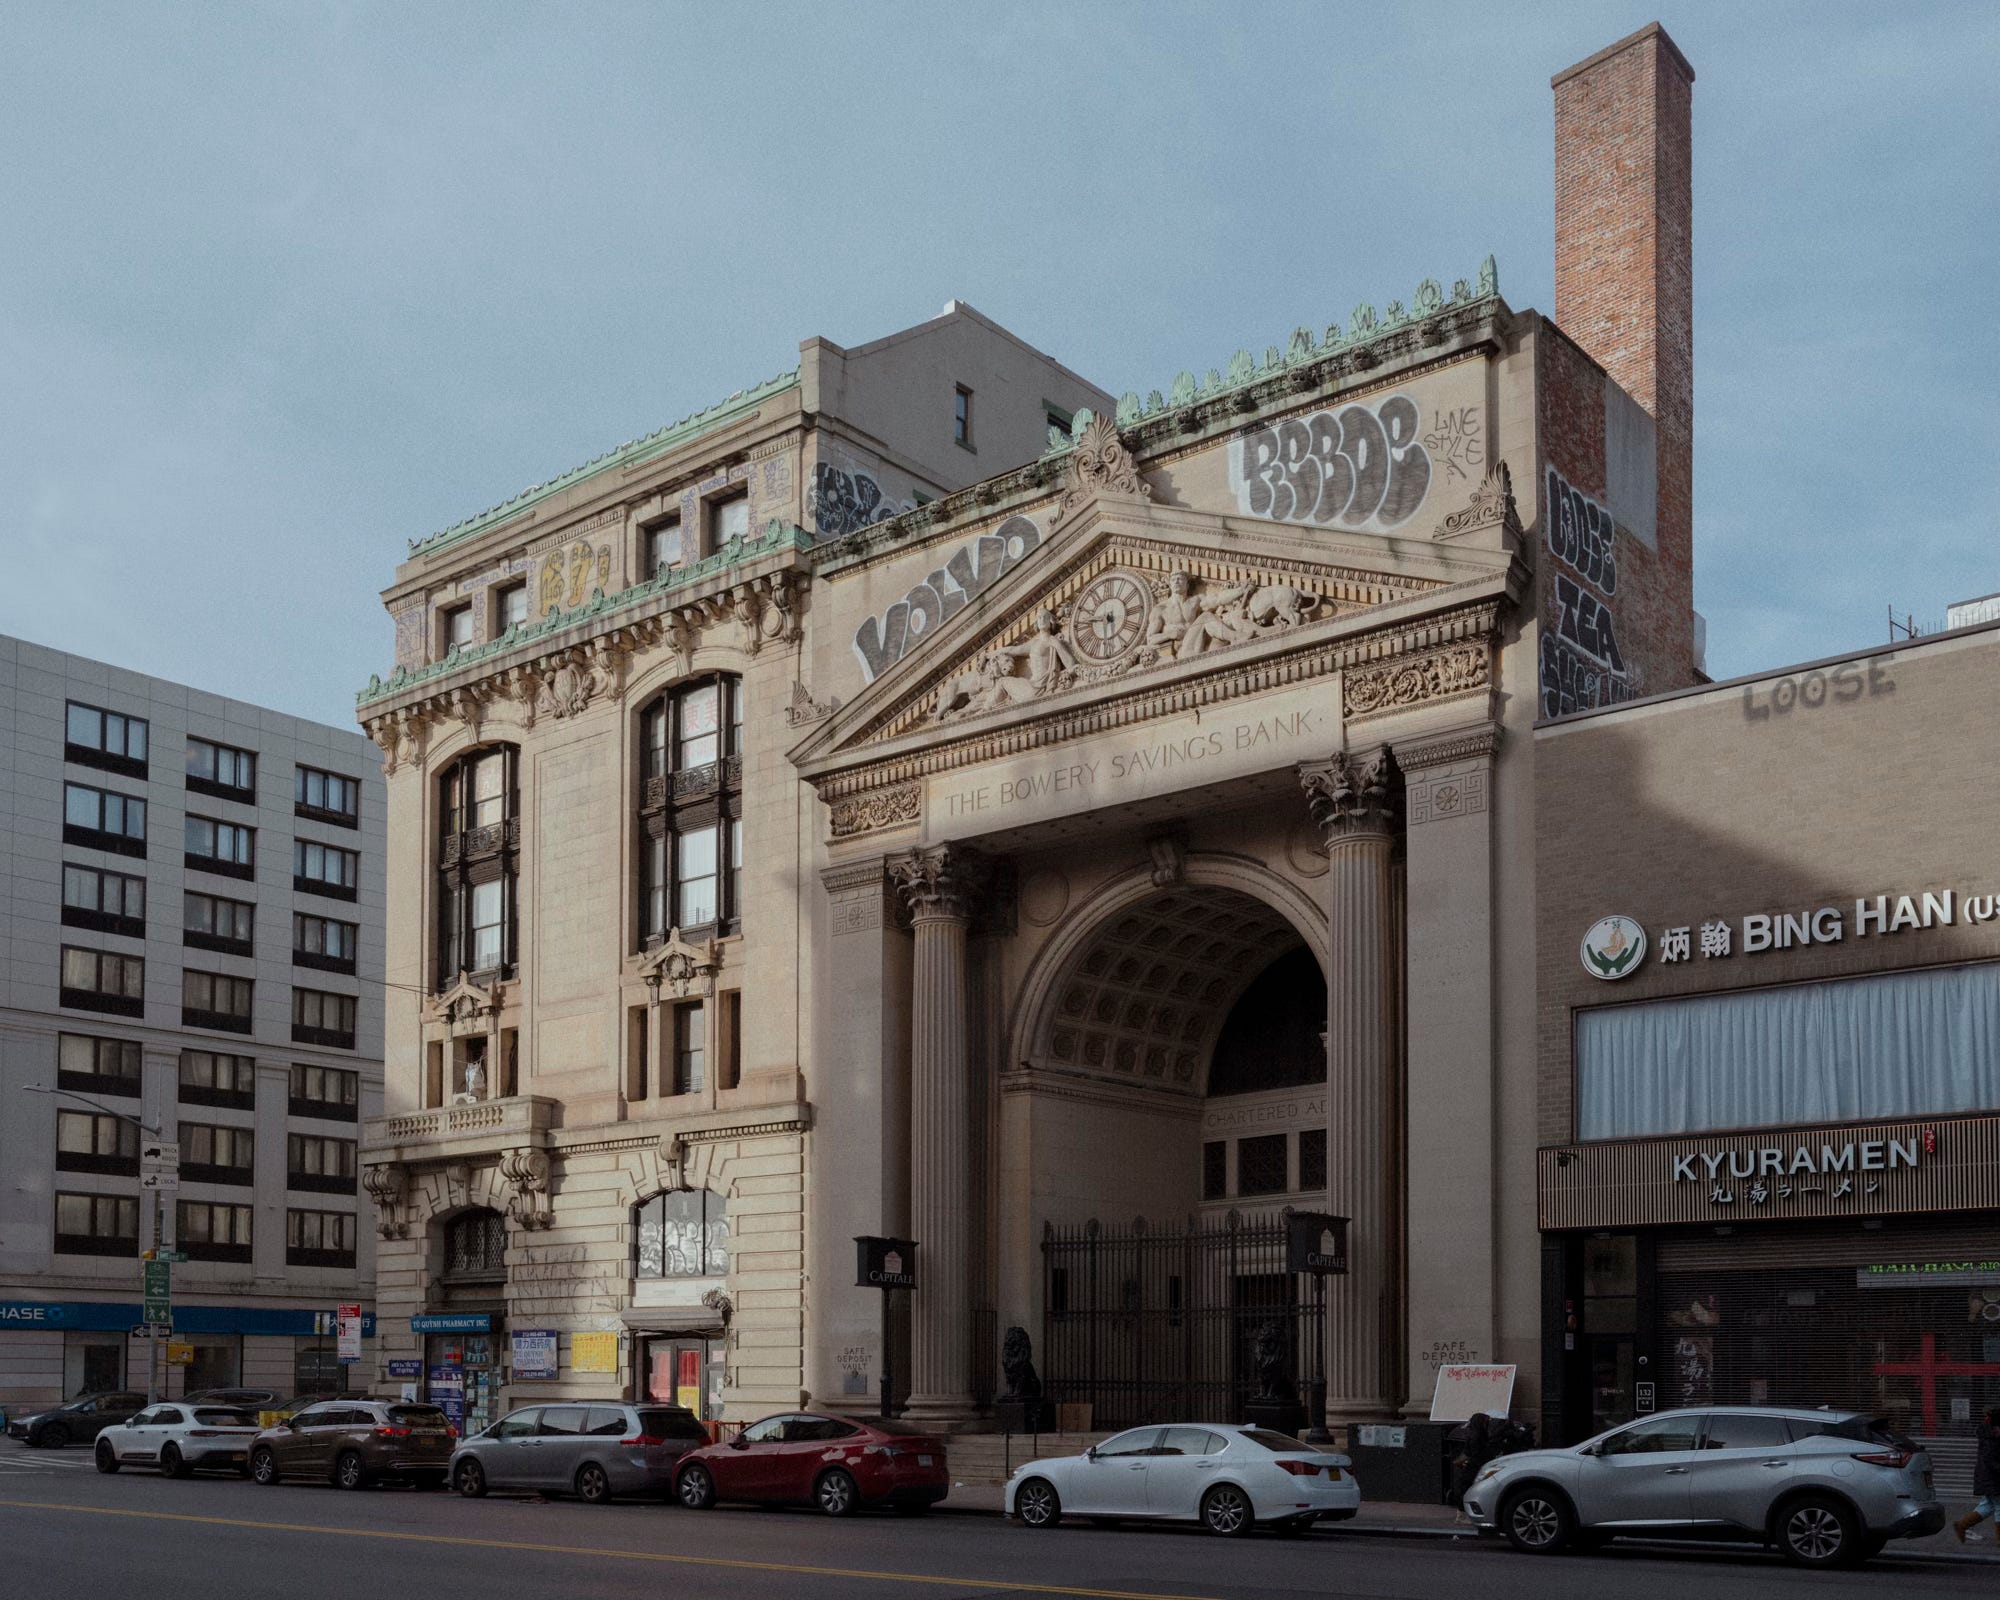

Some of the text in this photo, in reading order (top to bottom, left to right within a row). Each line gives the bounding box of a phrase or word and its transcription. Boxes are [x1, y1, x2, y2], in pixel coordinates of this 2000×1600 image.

[853, 514, 1041, 686] VOLVO
[1555, 571, 1627, 678] TEA
[1743, 653, 1897, 721] LOOSE
[945, 708, 1313, 817] THE BOWERY SAVINGS BANK
[1743, 908, 1843, 953] BING
[1855, 889, 1951, 937] HAN
[1207, 1103, 1298, 1127] CHARTERED
[1673, 1138, 1918, 1181] KYURAMEN
[1709, 1178, 1879, 1205] 九湯ラーメン
[442, 1319, 475, 1328] PHARMACY
[476, 1319, 489, 1327] INC.
[837, 1355, 872, 1363] DEPOSIT
[843, 1347, 865, 1355] SAFE
[1422, 1351, 1478, 1361] DEPOSIT
[1433, 1341, 1465, 1351] SAFE
